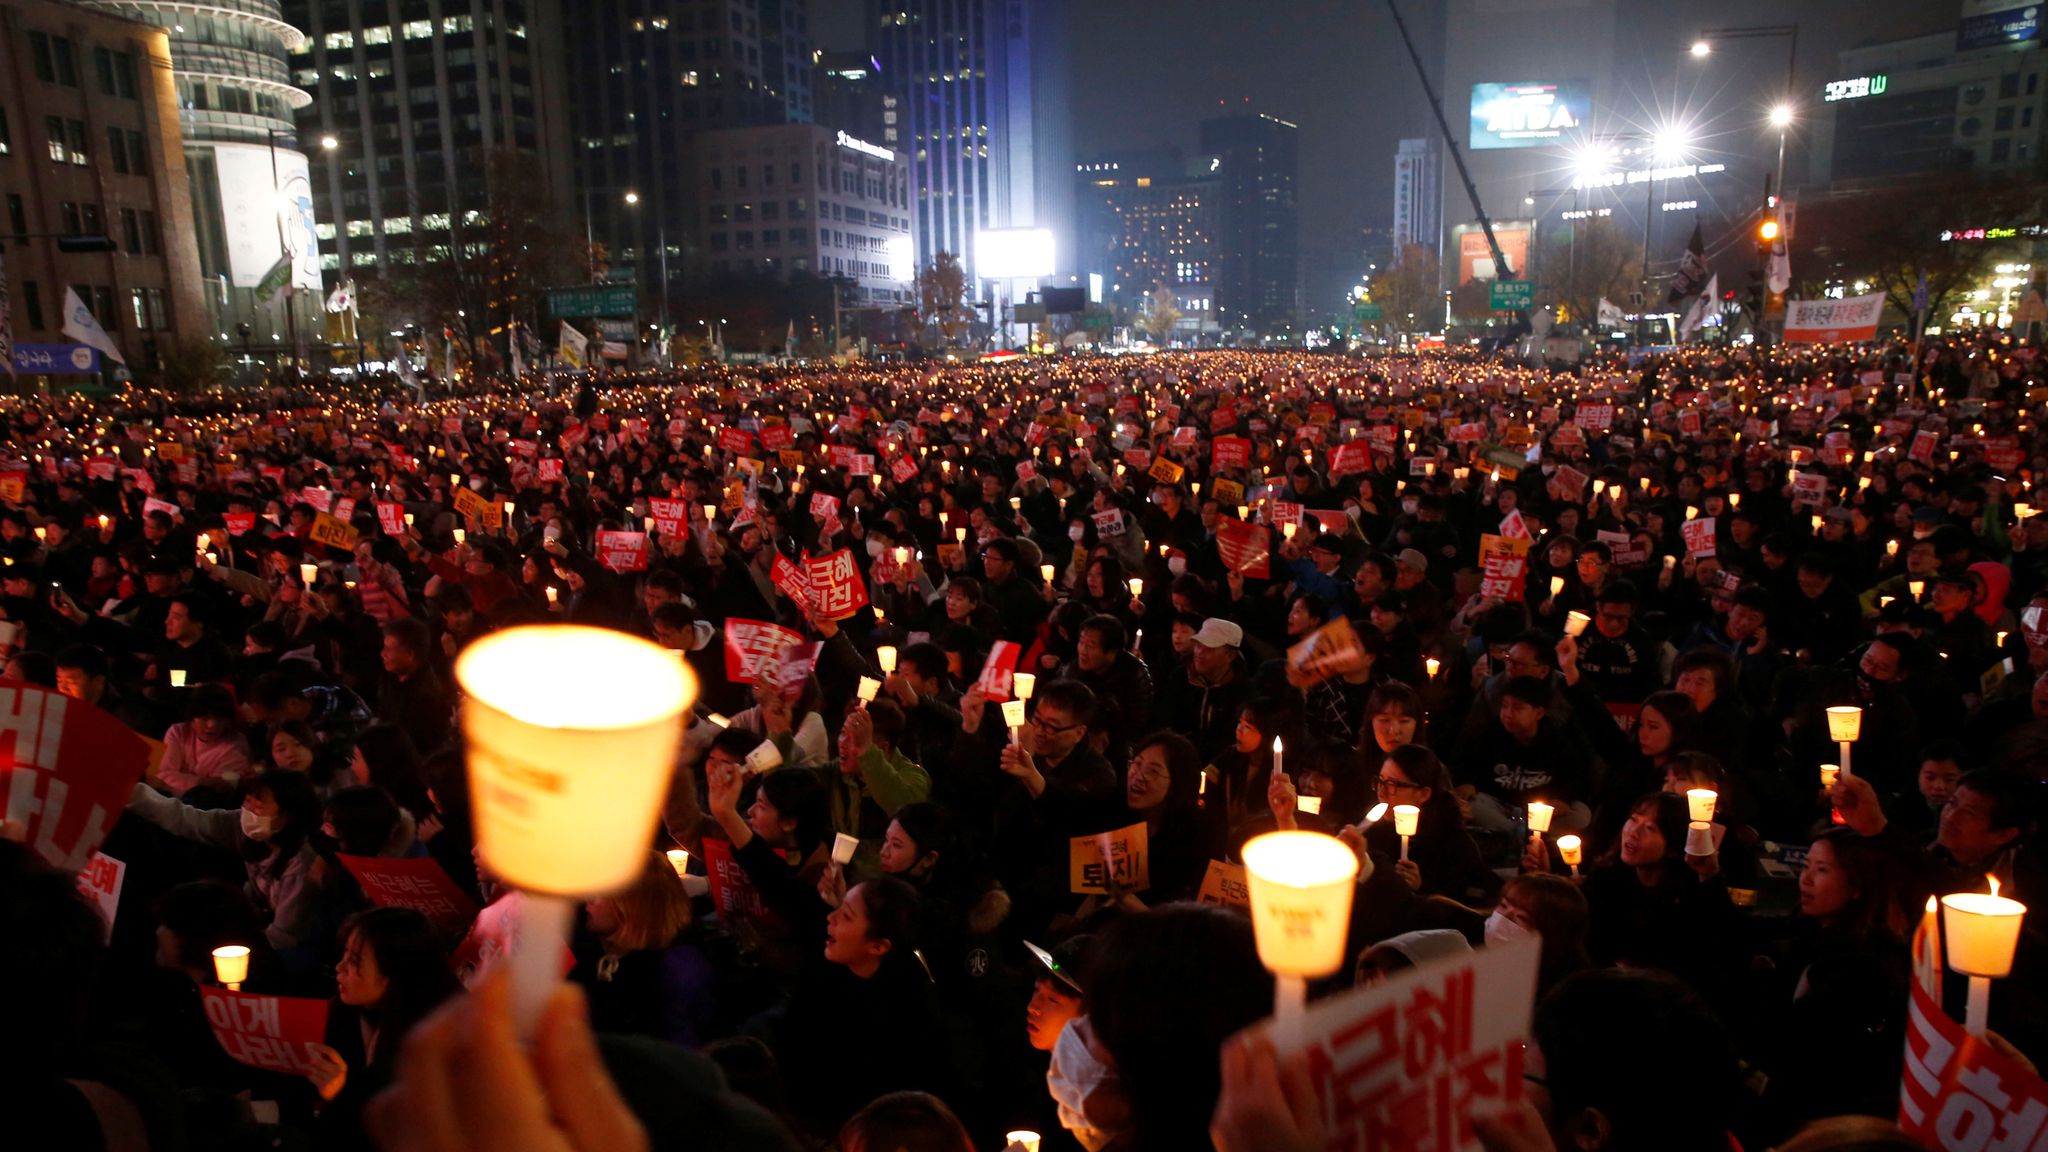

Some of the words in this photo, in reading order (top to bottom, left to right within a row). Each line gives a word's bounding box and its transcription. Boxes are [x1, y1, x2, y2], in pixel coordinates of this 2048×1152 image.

[1076, 162, 1119, 172] PLAZA
[602, 536, 643, 550] 박근혜
[806, 551, 854, 587] 근혜
[360, 871, 441, 896] 박근혜는
[202, 994, 282, 1039] 이게
